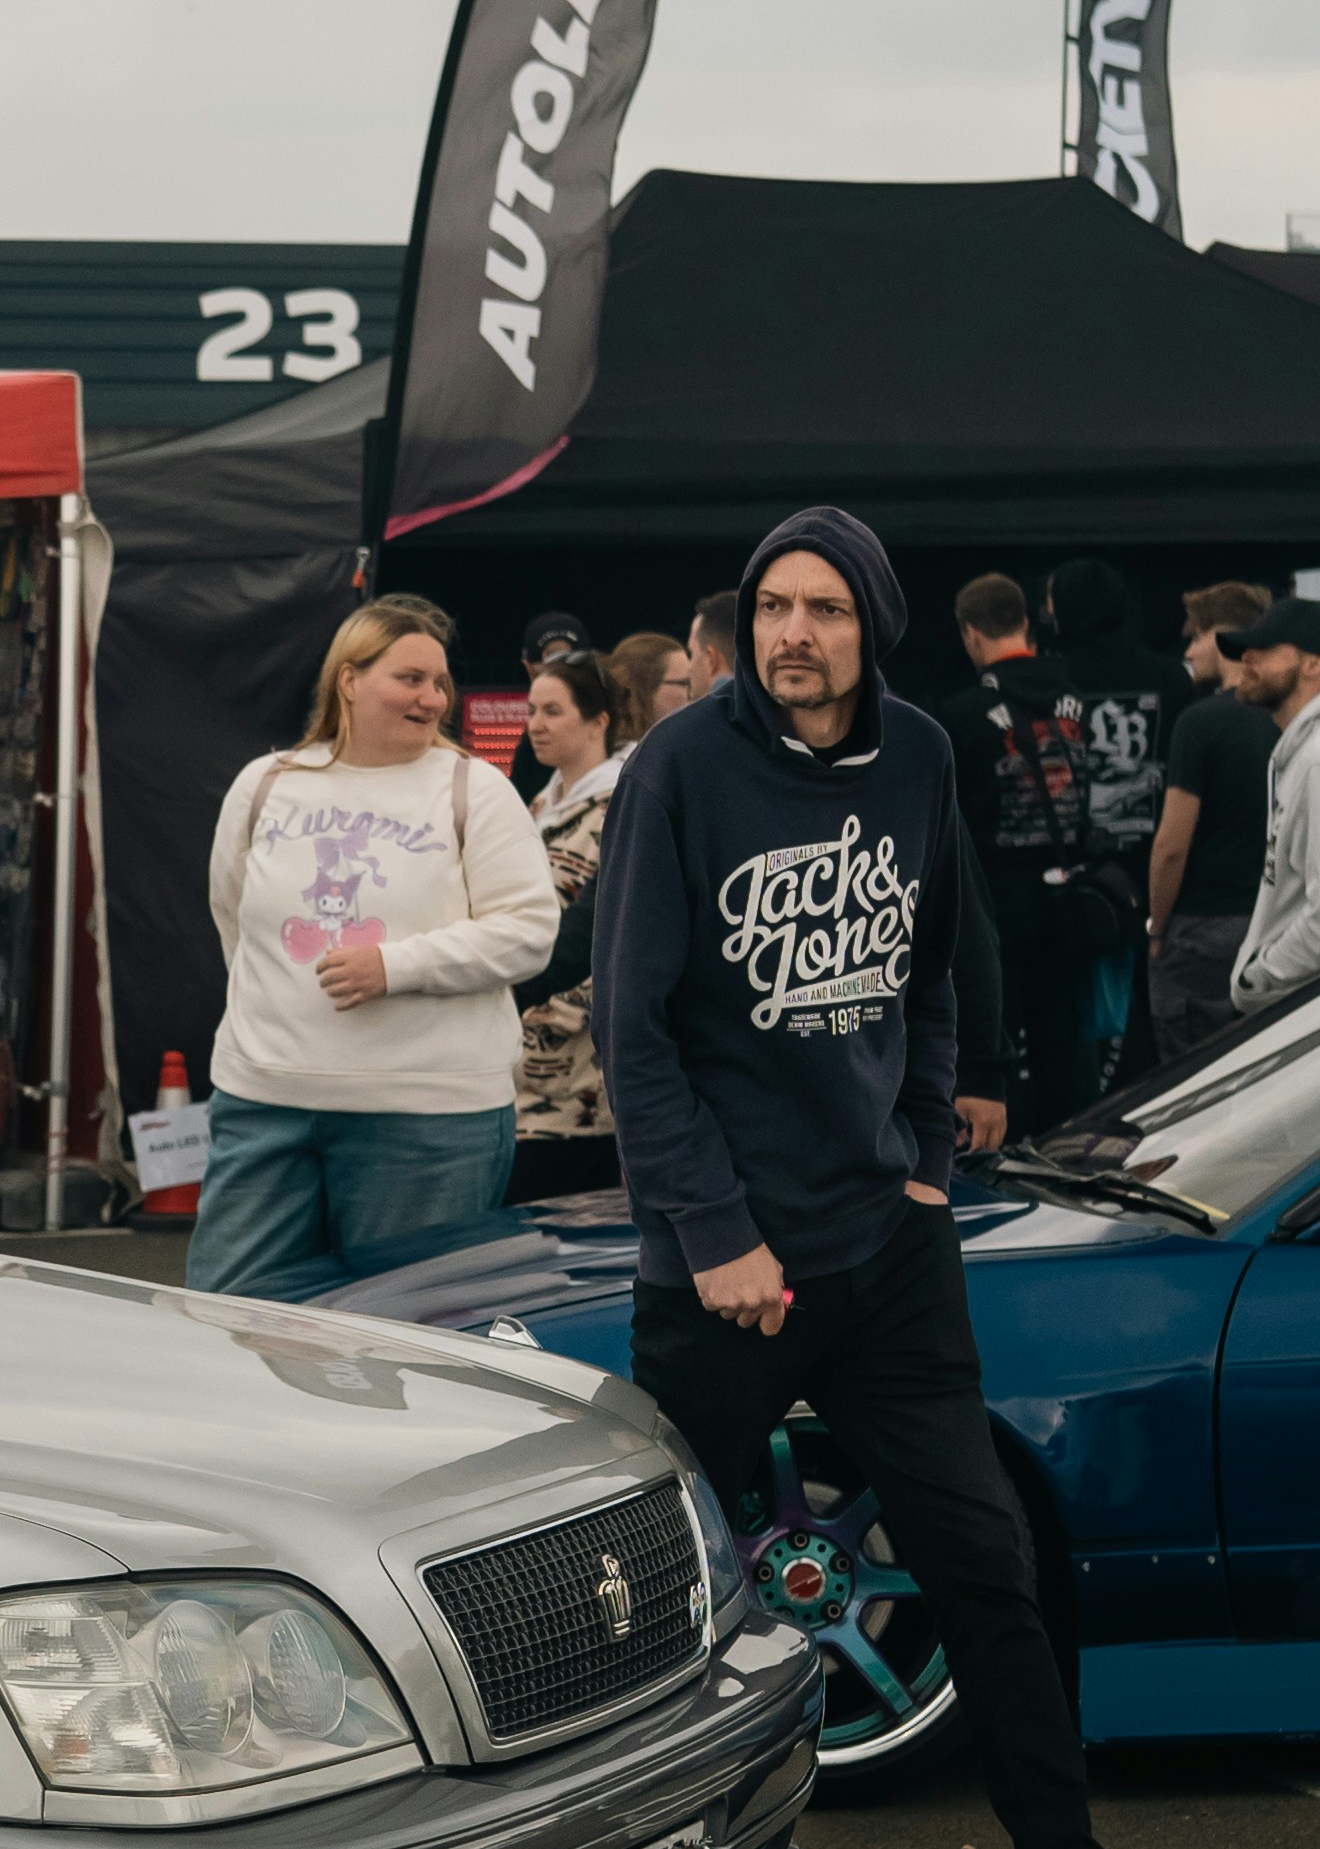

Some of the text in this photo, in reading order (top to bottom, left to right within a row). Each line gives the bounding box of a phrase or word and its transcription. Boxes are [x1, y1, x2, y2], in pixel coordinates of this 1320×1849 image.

[196, 286, 363, 384] 23
[768, 846, 814, 870] ORIGINALS
[719, 814, 904, 963] Jack &
[785, 993, 808, 1005] HAND
[810, 988, 828, 1001] AND
[828, 1006, 862, 1036] 1975
